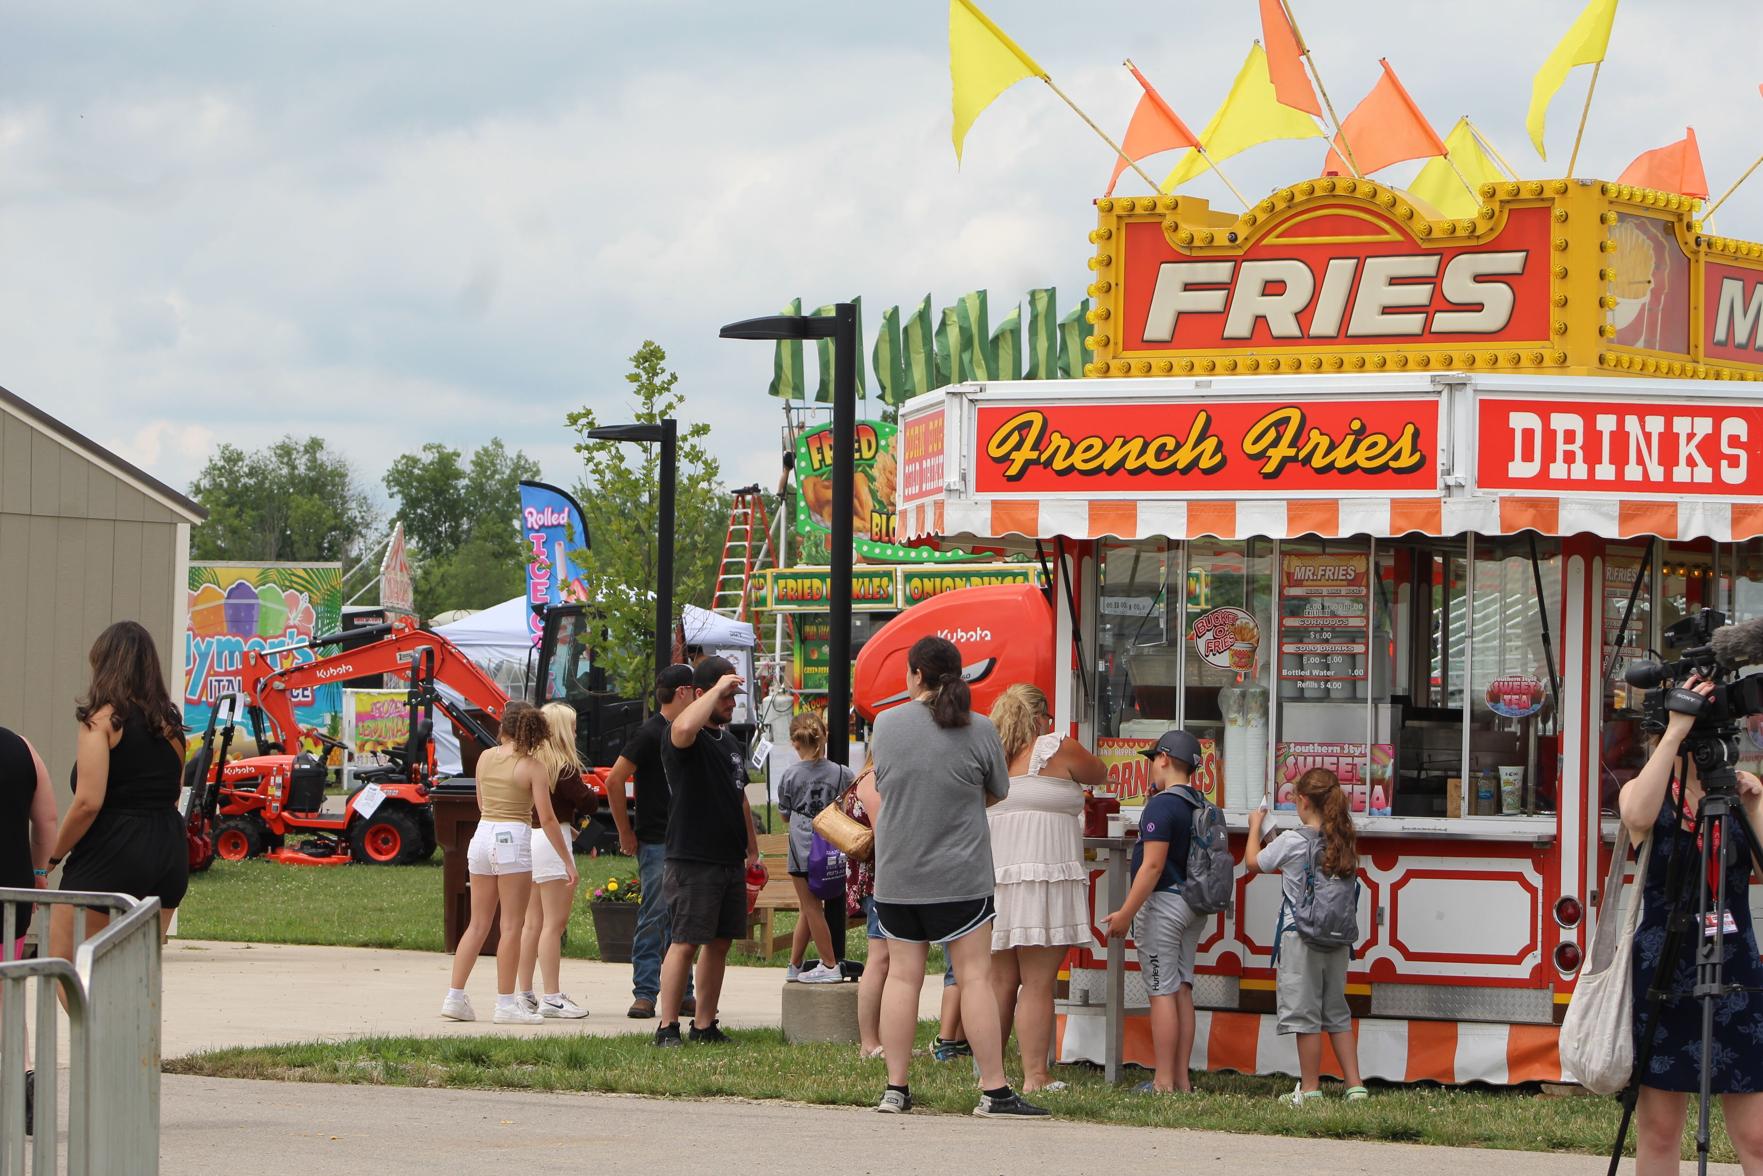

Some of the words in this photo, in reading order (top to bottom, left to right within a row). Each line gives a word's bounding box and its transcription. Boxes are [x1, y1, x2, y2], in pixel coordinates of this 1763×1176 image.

[1142, 250, 1529, 342] FRIES
[906, 422, 925, 460] CORN
[986, 406, 1227, 482] French
[1241, 405, 1427, 479] Fries
[1508, 411, 1748, 485] DRINKS
[905, 461, 920, 497] COLD
[525, 506, 569, 530] Rolled
[1294, 565, 1357, 581] MR.FRIES
[777, 578, 823, 601] FRIED
[1195, 611, 1238, 638] BUCKET
[1298, 617, 1349, 626] CORNDOGS
[937, 627, 992, 643] Kubota
[1205, 633, 1236, 657] FRIES
[316, 664, 353, 678] Kubota
[1493, 681, 1537, 695] SWEET
[1503, 695, 1531, 709] TEA
[1289, 743, 1341, 753] Southern
[224, 766, 255, 775] Kubota
[1284, 755, 1368, 781] SWEET
[1151, 963, 1160, 991] Hurley
